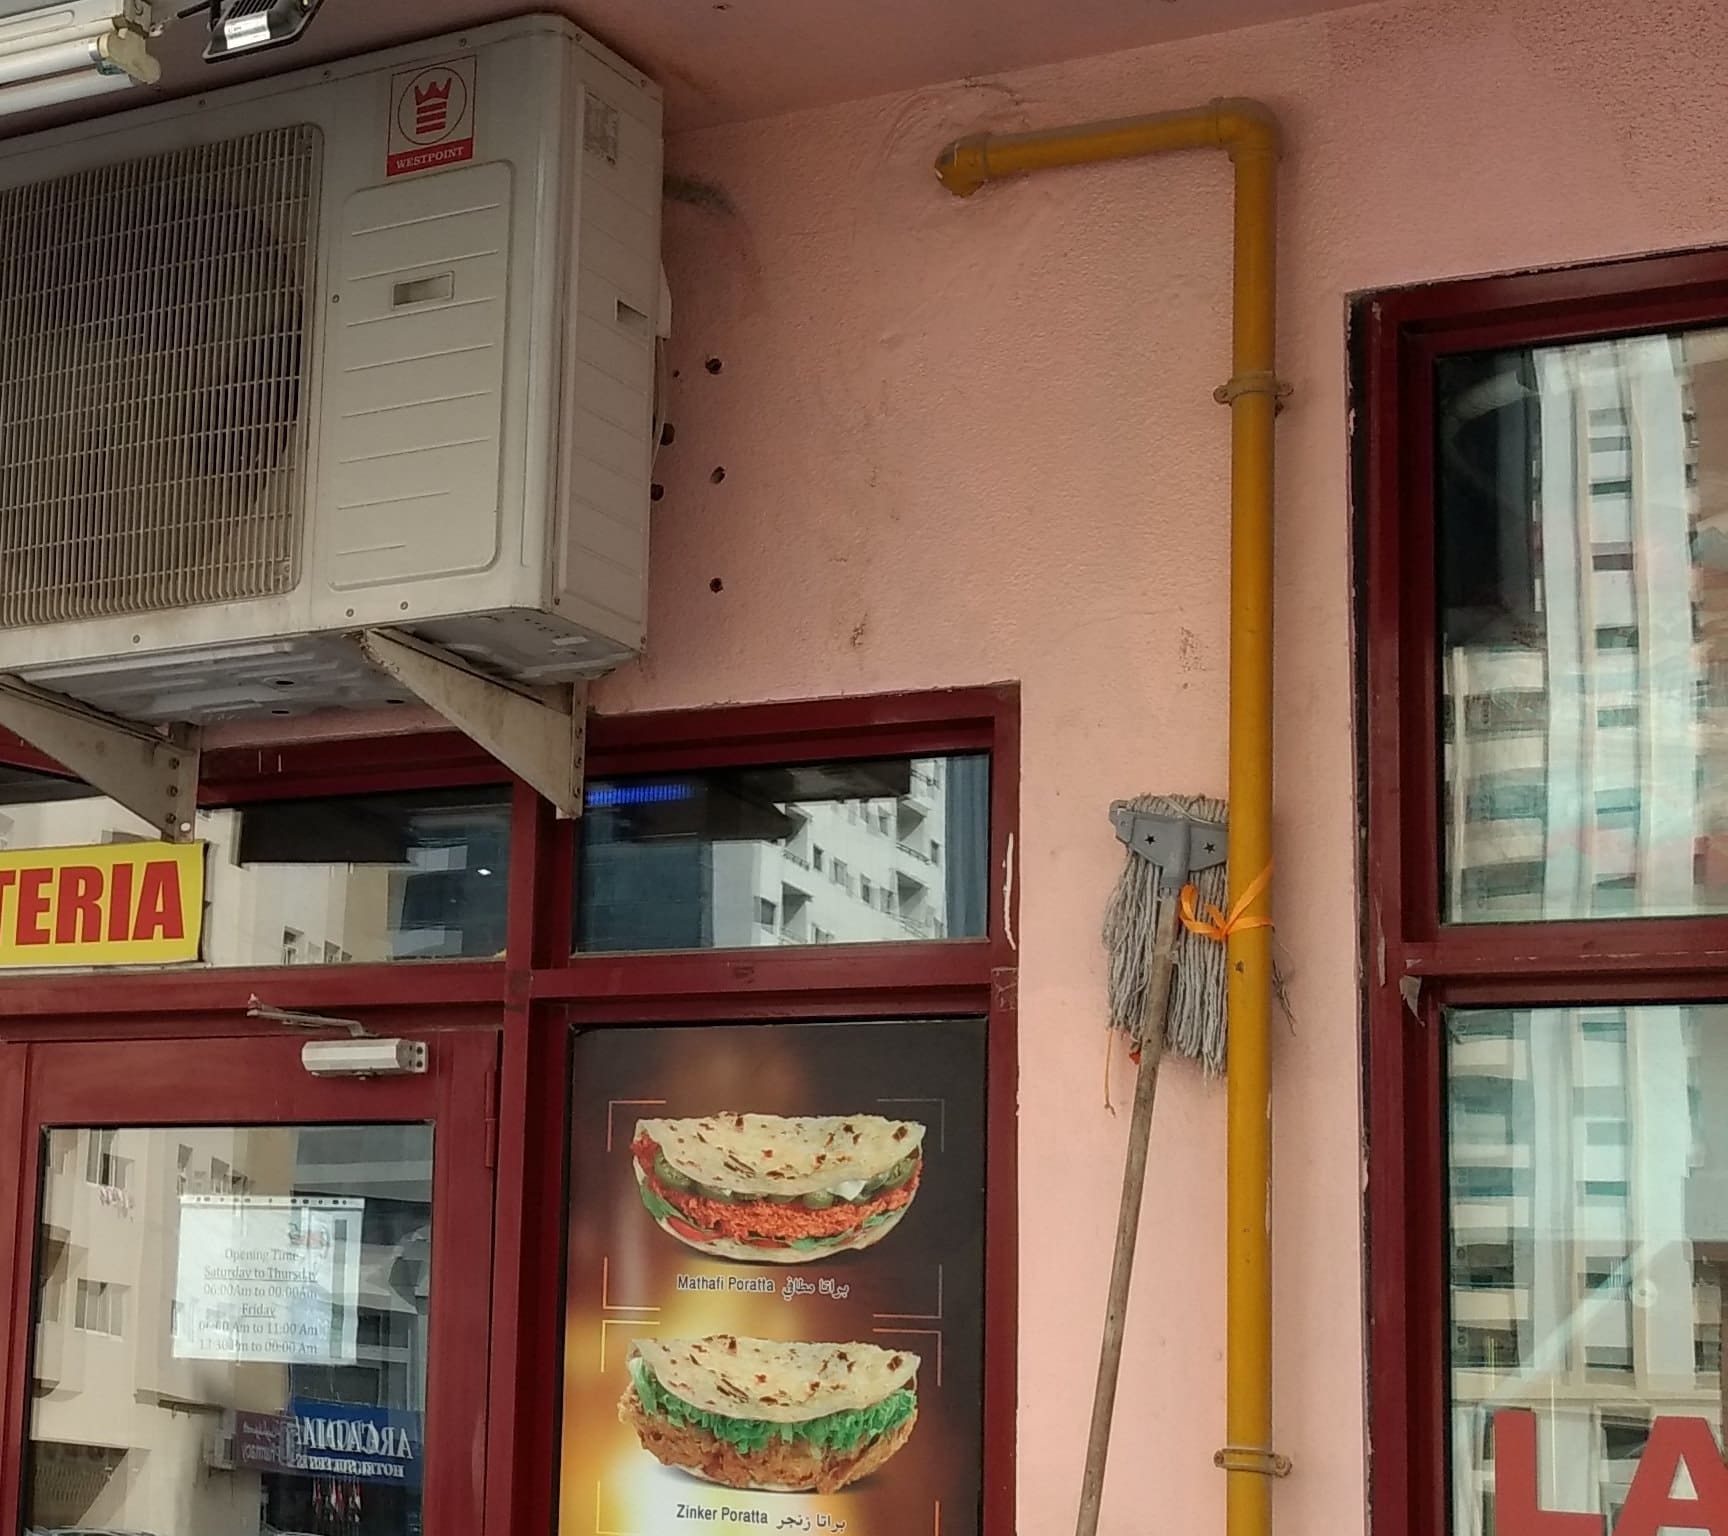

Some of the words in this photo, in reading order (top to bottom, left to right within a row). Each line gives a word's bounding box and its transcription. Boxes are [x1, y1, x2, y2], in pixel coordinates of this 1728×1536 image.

[395, 146, 465, 170] WESTPOINT
[225, 1248, 269, 1262] Opening
[204, 1266, 252, 1280] Saturday
[254, 1267, 265, 1279] to
[267, 1266, 318, 1282] Thursday
[254, 1286, 265, 1297] to
[677, 1275, 723, 1291] Mathafi
[728, 1277, 774, 1292] Poratta
[819, 1278, 849, 1299] براتا
[241, 1302, 276, 1317] Friday
[253, 1322, 263, 1334] to
[298, 1323, 318, 1336] Am
[251, 1340, 263, 1352] to
[298, 1341, 318, 1354] Am
[676, 1503, 718, 1520] Zinker
[722, 1507, 768, 1524] Poratta
[776, 1515, 810, 1531] زنجر
[816, 1514, 846, 1532] براتا
